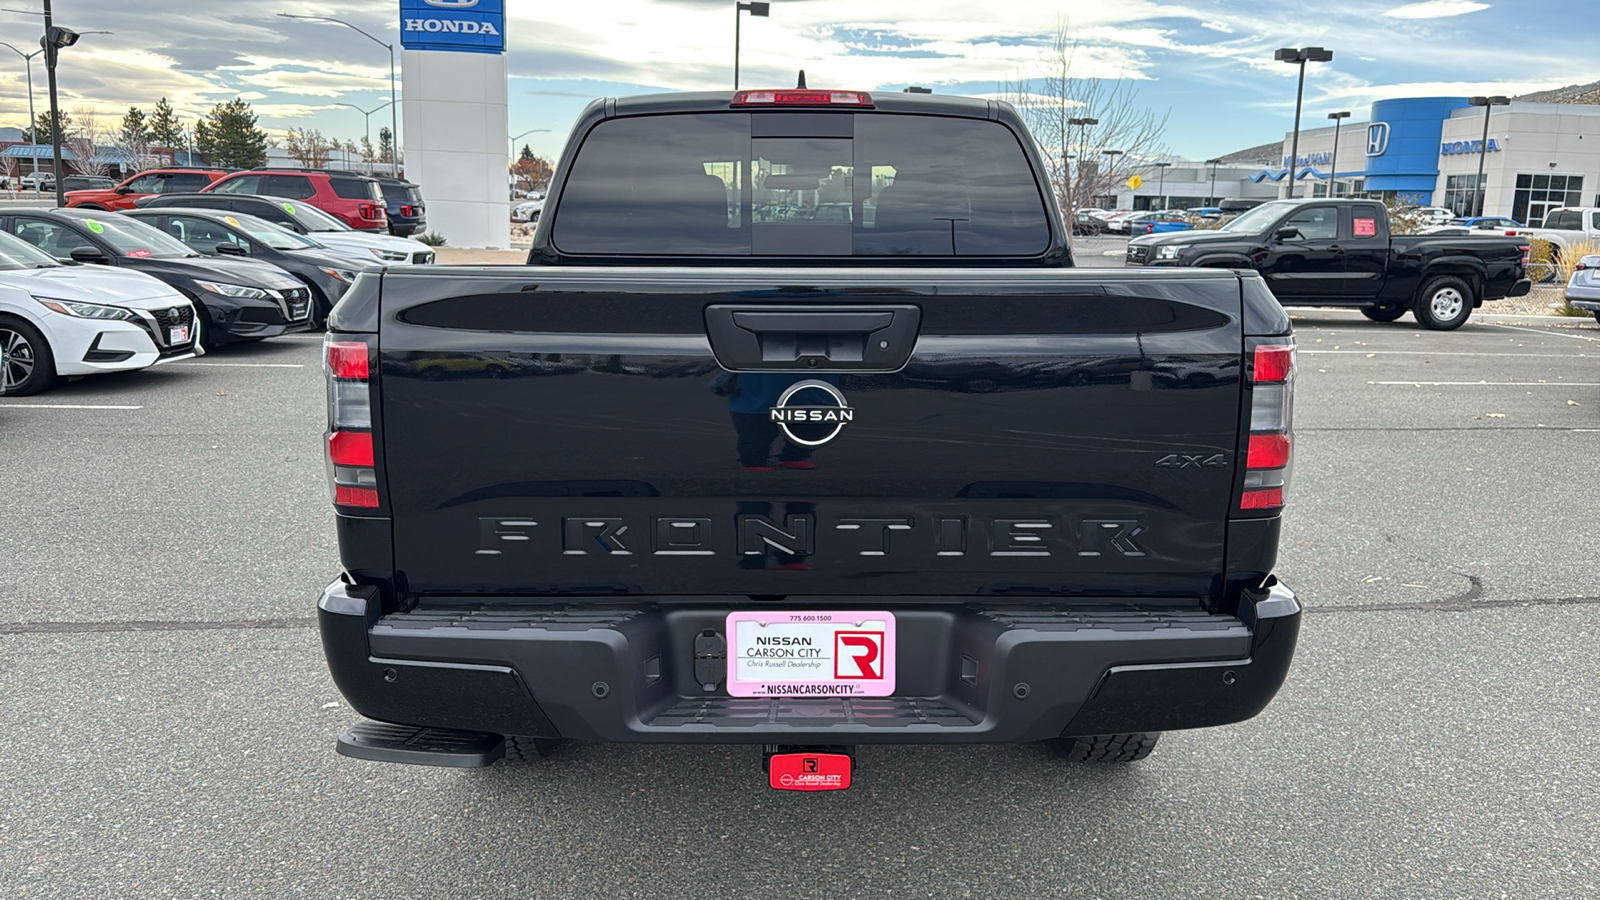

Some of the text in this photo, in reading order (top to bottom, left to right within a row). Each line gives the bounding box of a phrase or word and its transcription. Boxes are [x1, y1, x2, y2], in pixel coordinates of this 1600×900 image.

[404, 18, 500, 36] HONDA
[1440, 138, 1501, 156] HONDA
[771, 409, 853, 421] NISSAN
[474, 515, 1147, 556] FRONTIER
[756, 636, 812, 646] NISSAN
[746, 648, 822, 658] CARSON CITY
[746, 660, 822, 670] Chris Russell Dealership
